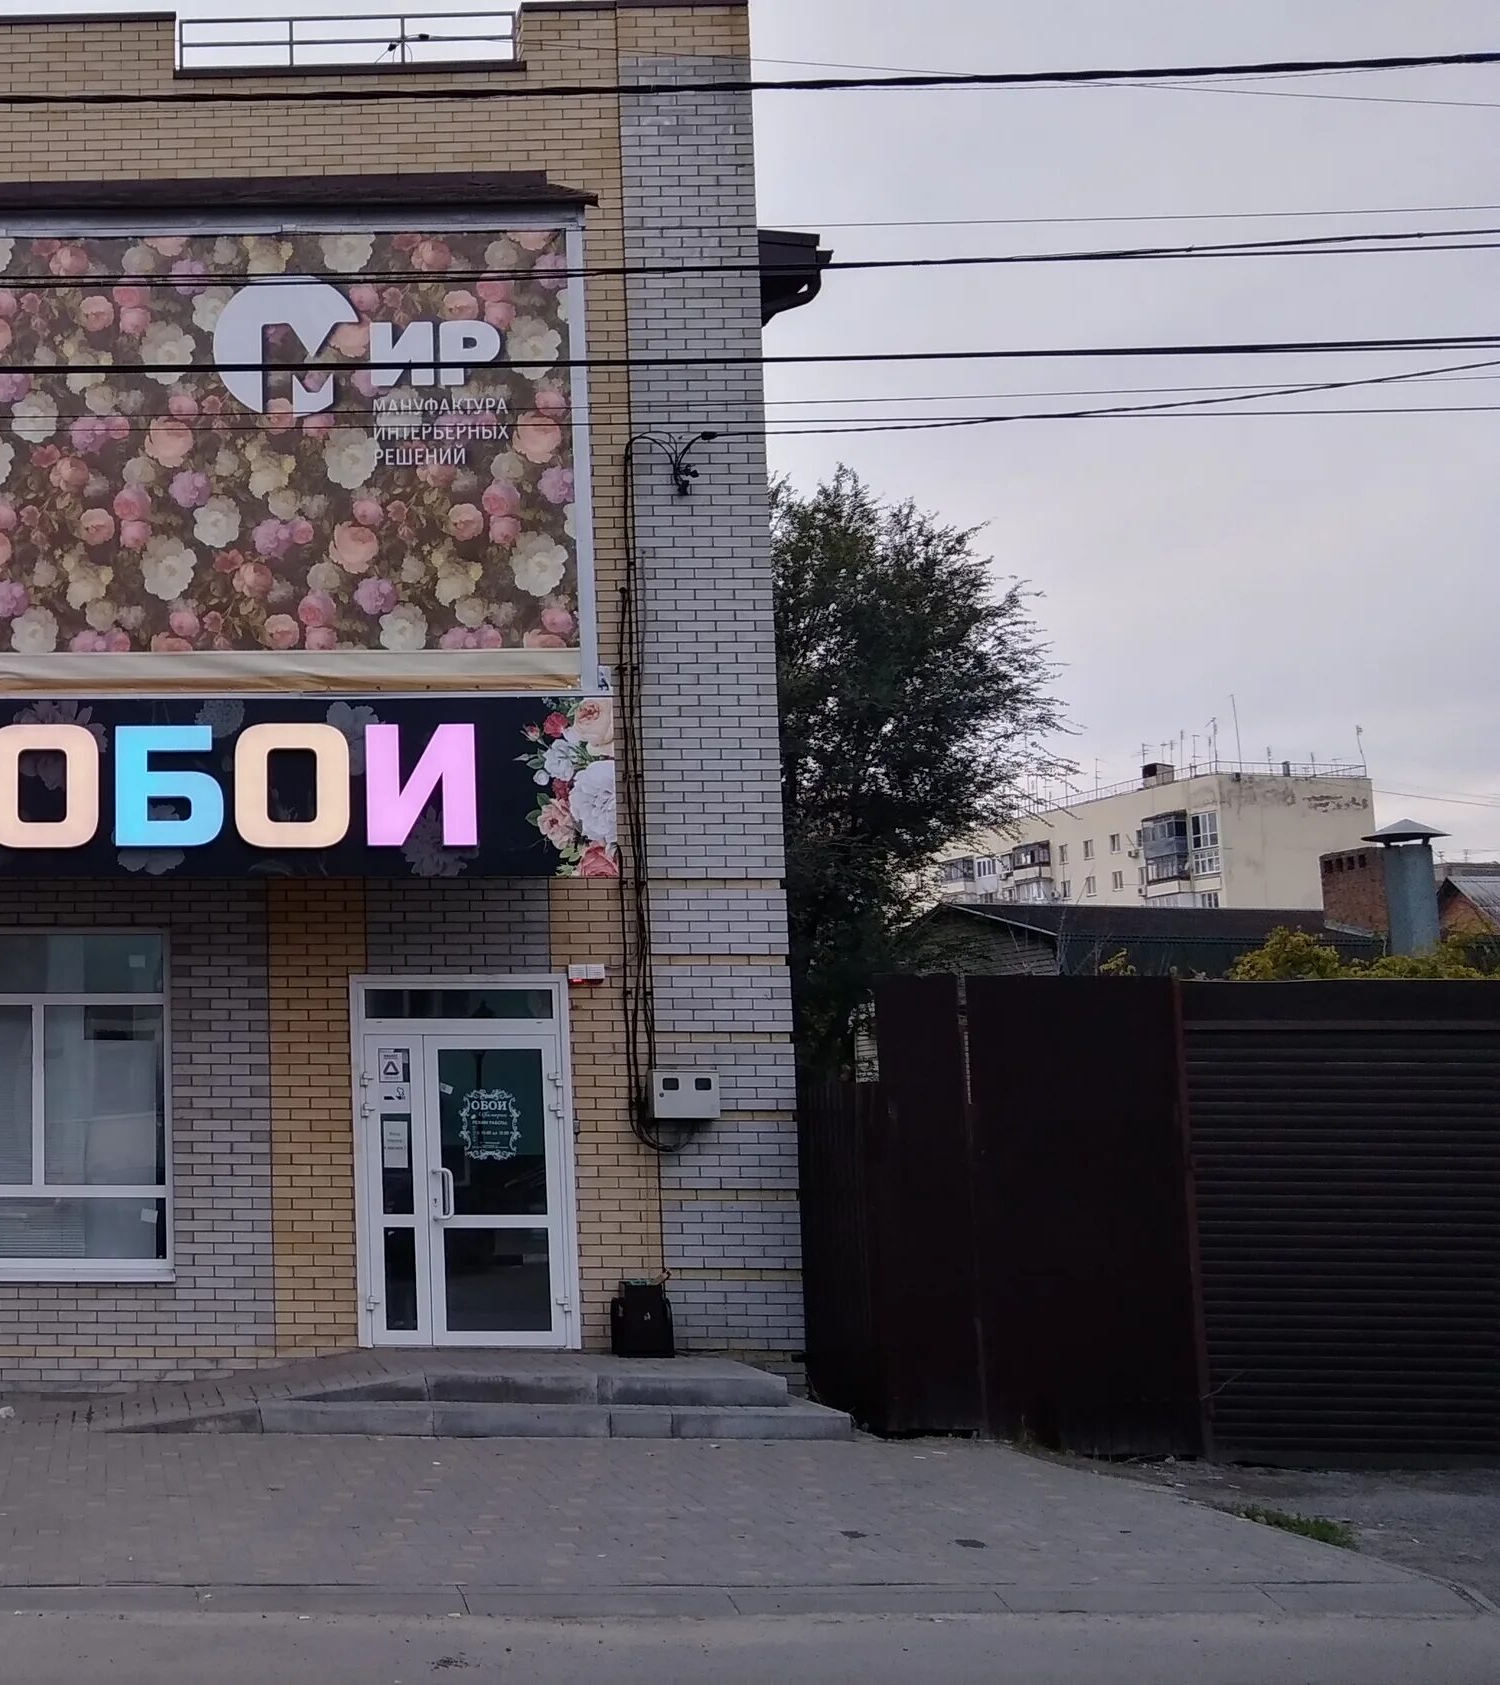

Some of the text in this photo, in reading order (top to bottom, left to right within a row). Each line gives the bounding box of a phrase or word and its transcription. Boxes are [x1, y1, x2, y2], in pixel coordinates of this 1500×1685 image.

[372, 397, 509, 416] МАНУФАКТУРА
[372, 422, 510, 440] ИНТЕРЬЕРНЫХ
[374, 444, 466, 466] РЕШЕНИЙ
[471, 1100, 508, 1111] ОБОИ
